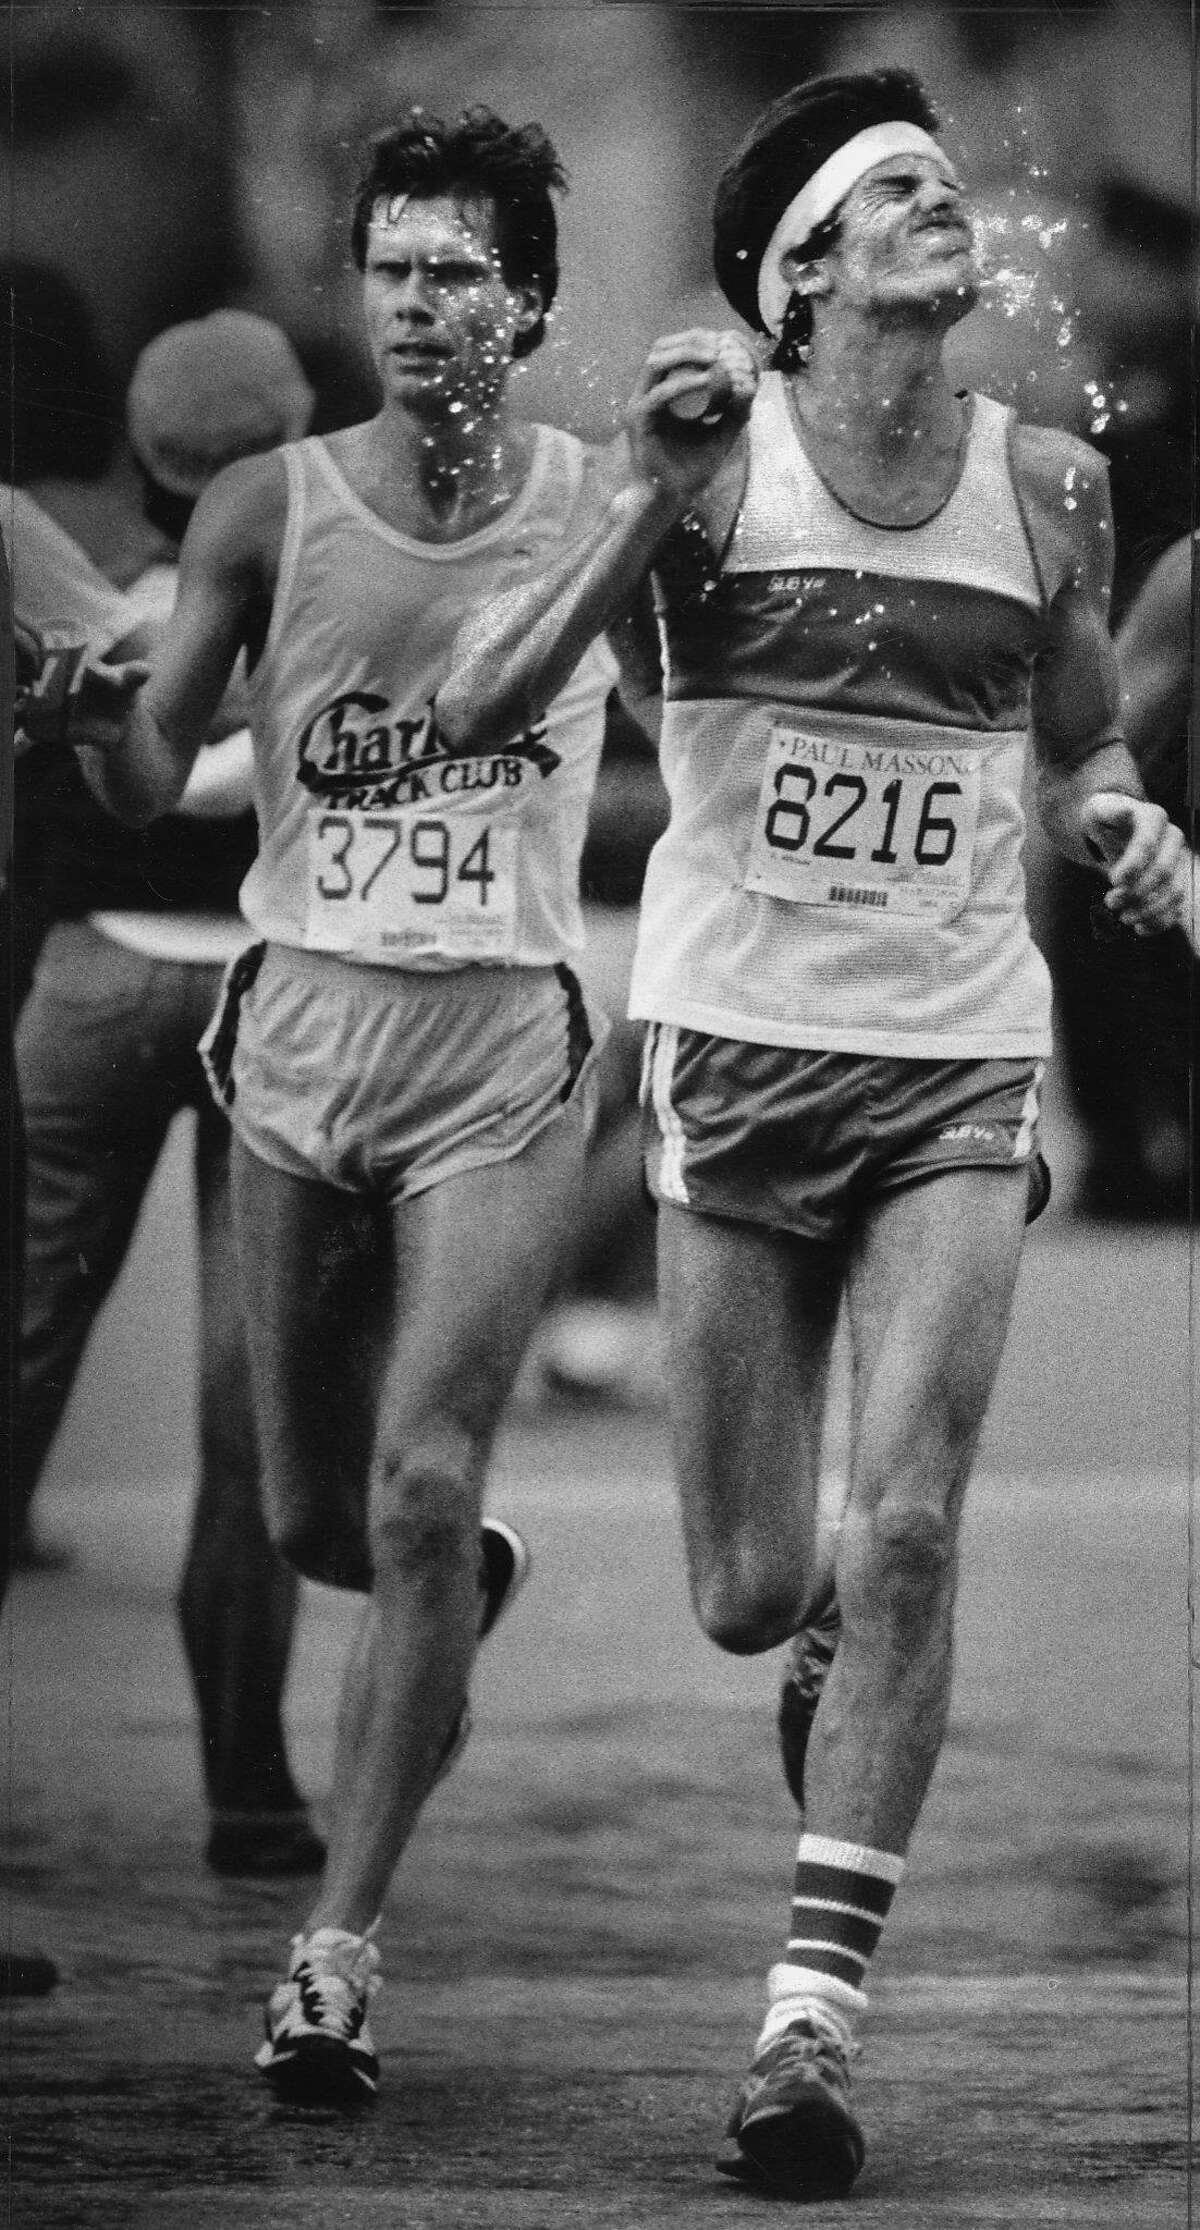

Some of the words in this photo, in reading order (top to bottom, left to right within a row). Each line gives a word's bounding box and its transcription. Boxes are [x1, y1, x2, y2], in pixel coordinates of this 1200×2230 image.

[440, 757, 522, 793] CLUB
[790, 737, 853, 768] PAUL
[862, 751, 965, 776] MASSON
[764, 762, 963, 867] 8216
[317, 815, 495, 907] 3794
